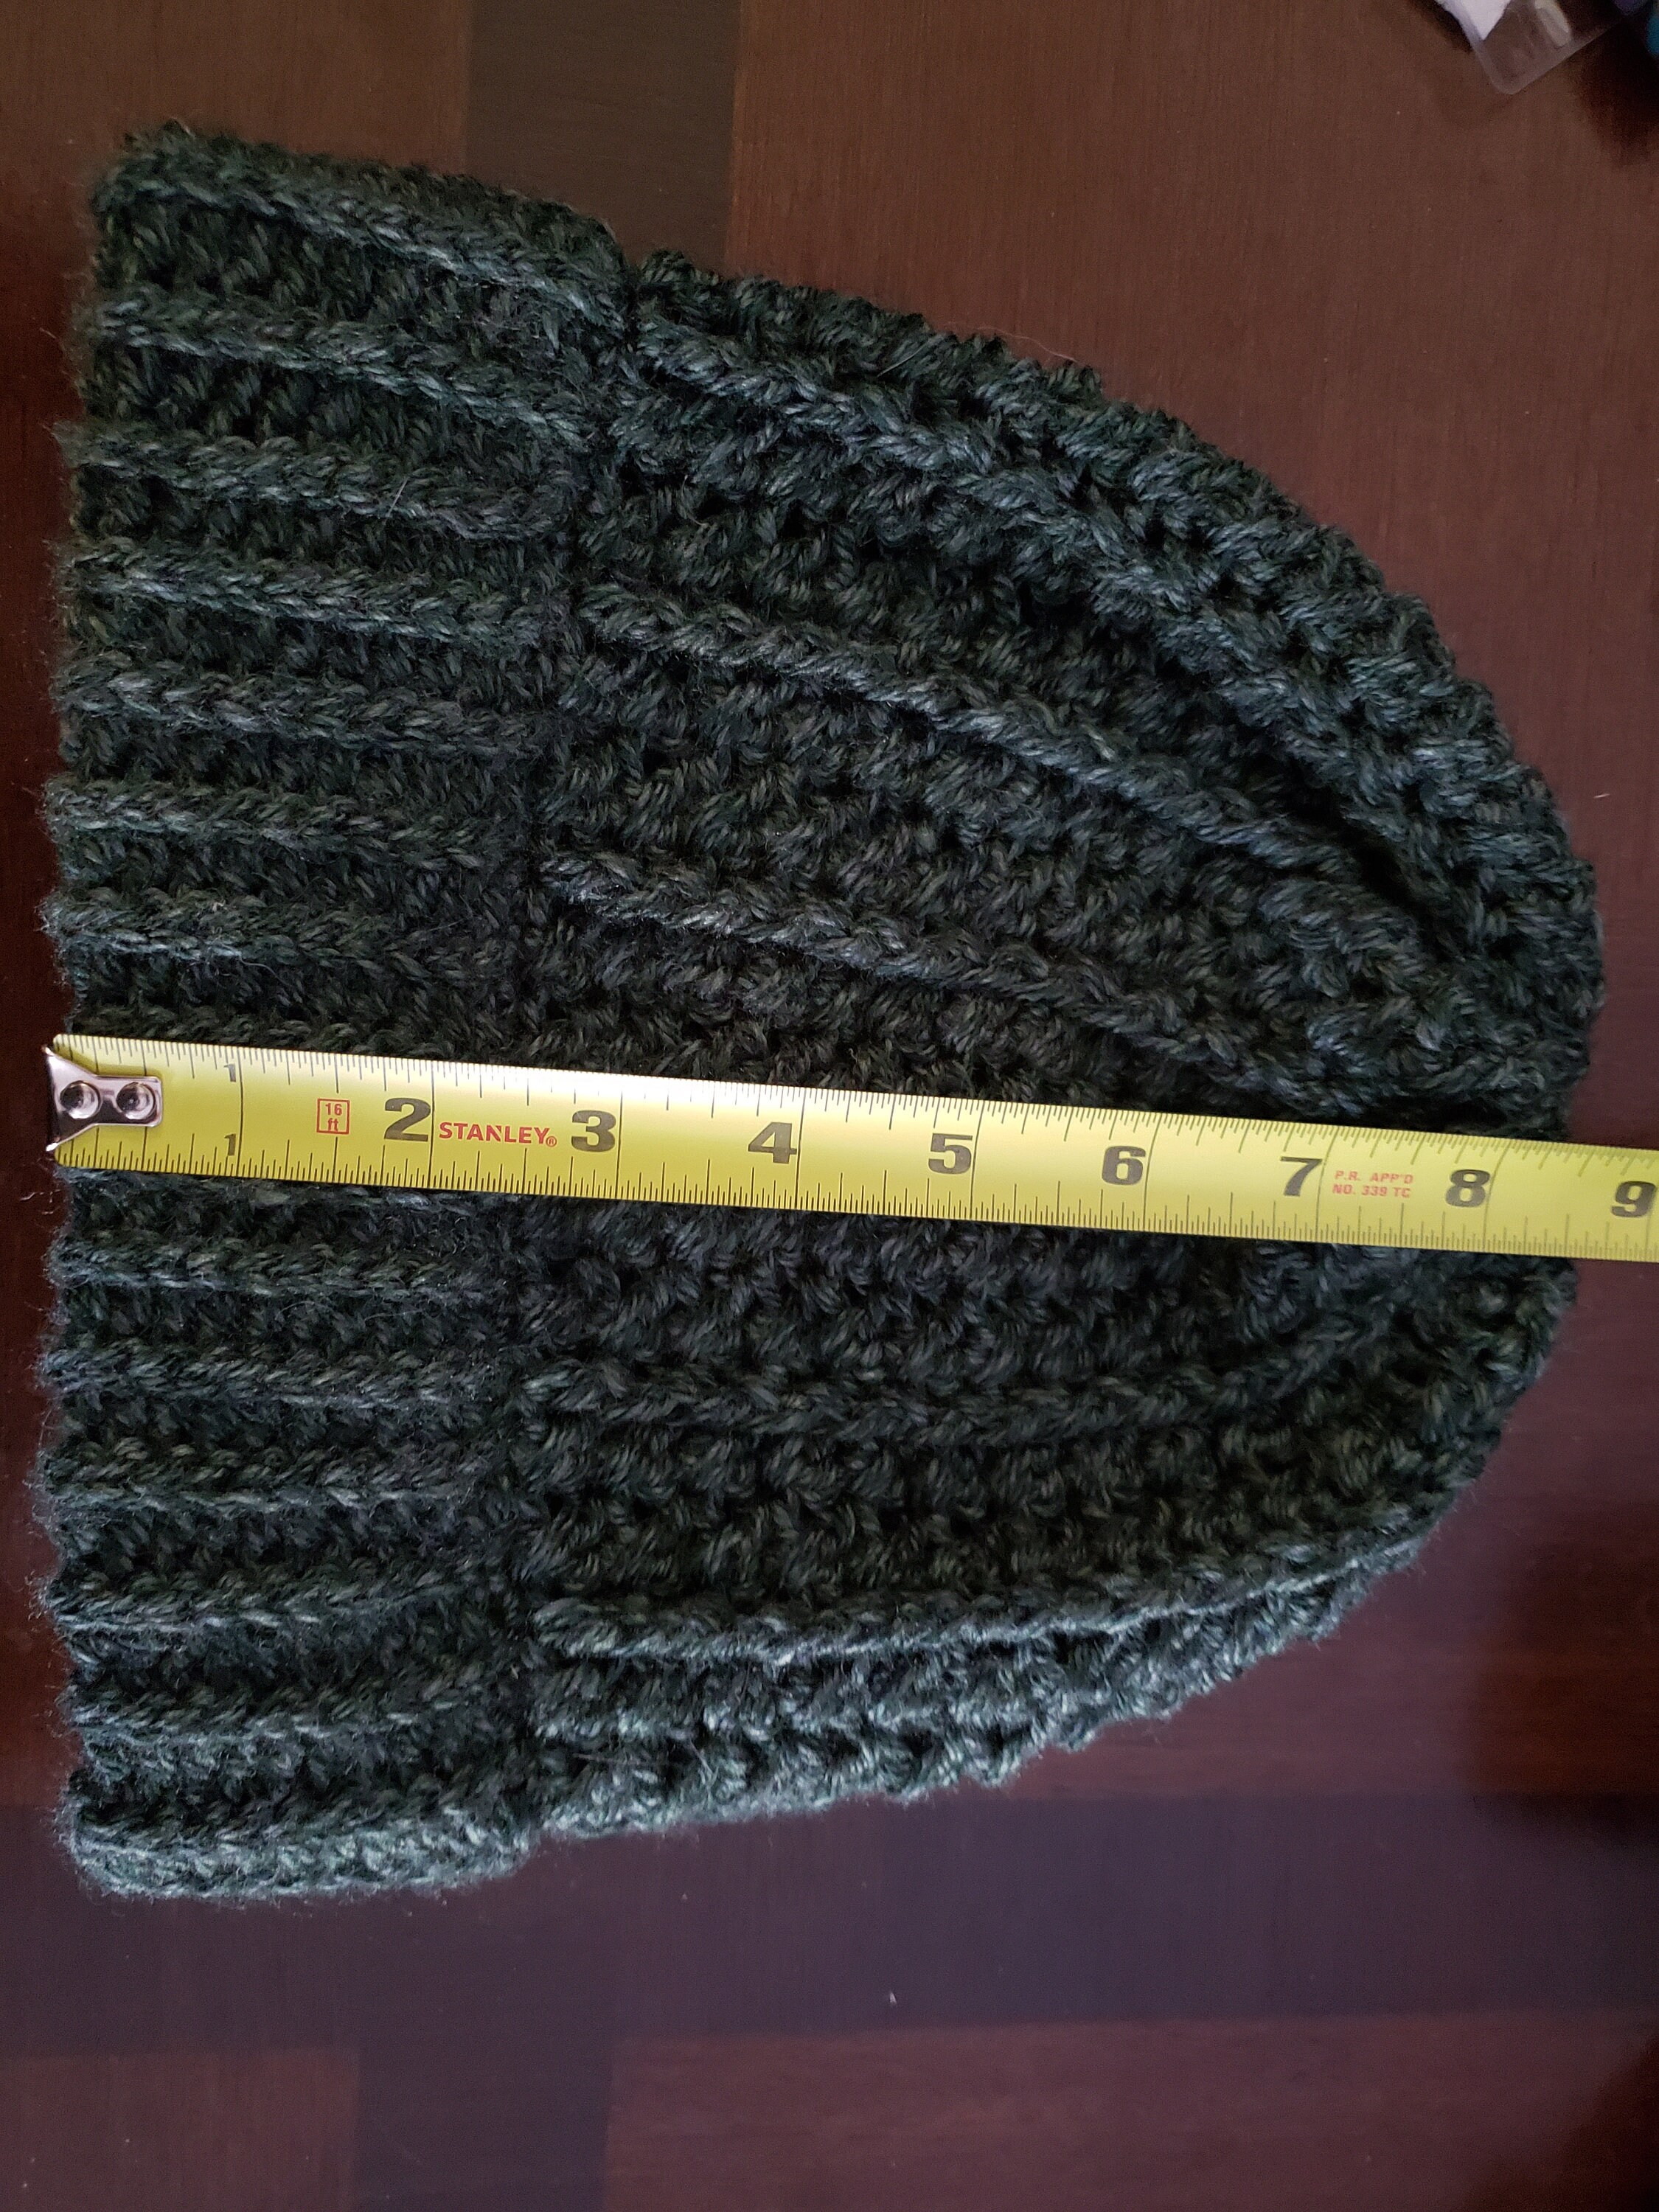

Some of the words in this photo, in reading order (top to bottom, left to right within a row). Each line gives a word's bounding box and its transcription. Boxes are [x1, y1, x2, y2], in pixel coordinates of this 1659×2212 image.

[223, 1063, 237, 1082] 1
[325, 1102, 343, 1116] 16
[327, 1117, 339, 1132] ft
[383, 1097, 431, 1142] 2
[223, 1133, 237, 1156] 1
[571, 1110, 616, 1152] 3
[748, 1121, 797, 1164] 4
[928, 1132, 973, 1176] 5
[1102, 1145, 1147, 1186] 6
[1279, 1155, 1323, 1197] 7
[1332, 1184, 1357, 1195] NO.
[1393, 1186, 1411, 1198] TC
[1445, 1169, 1491, 1208] 8
[1610, 1180, 1658, 1219] 9
